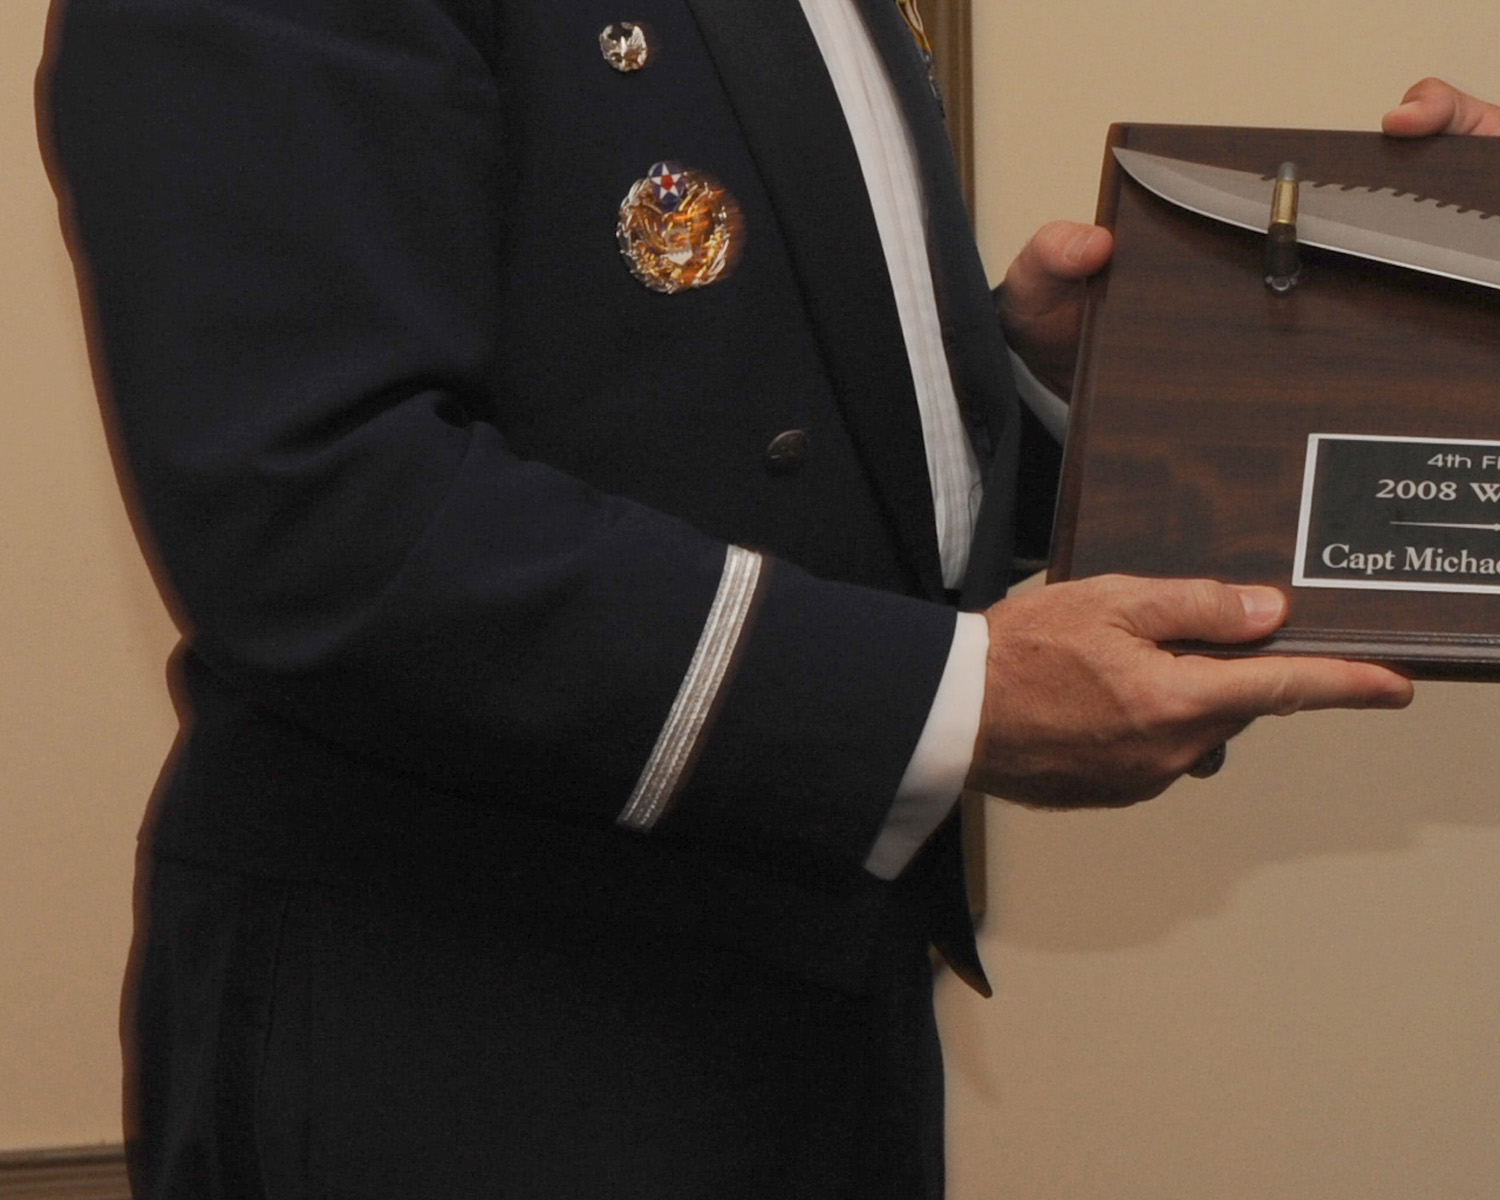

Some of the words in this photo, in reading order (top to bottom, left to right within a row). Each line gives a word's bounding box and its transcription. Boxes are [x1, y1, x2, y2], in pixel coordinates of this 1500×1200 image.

[1427, 453, 1471, 469] 4th
[1375, 479, 1457, 501] 2008
[1321, 543, 1395, 574] Capt
